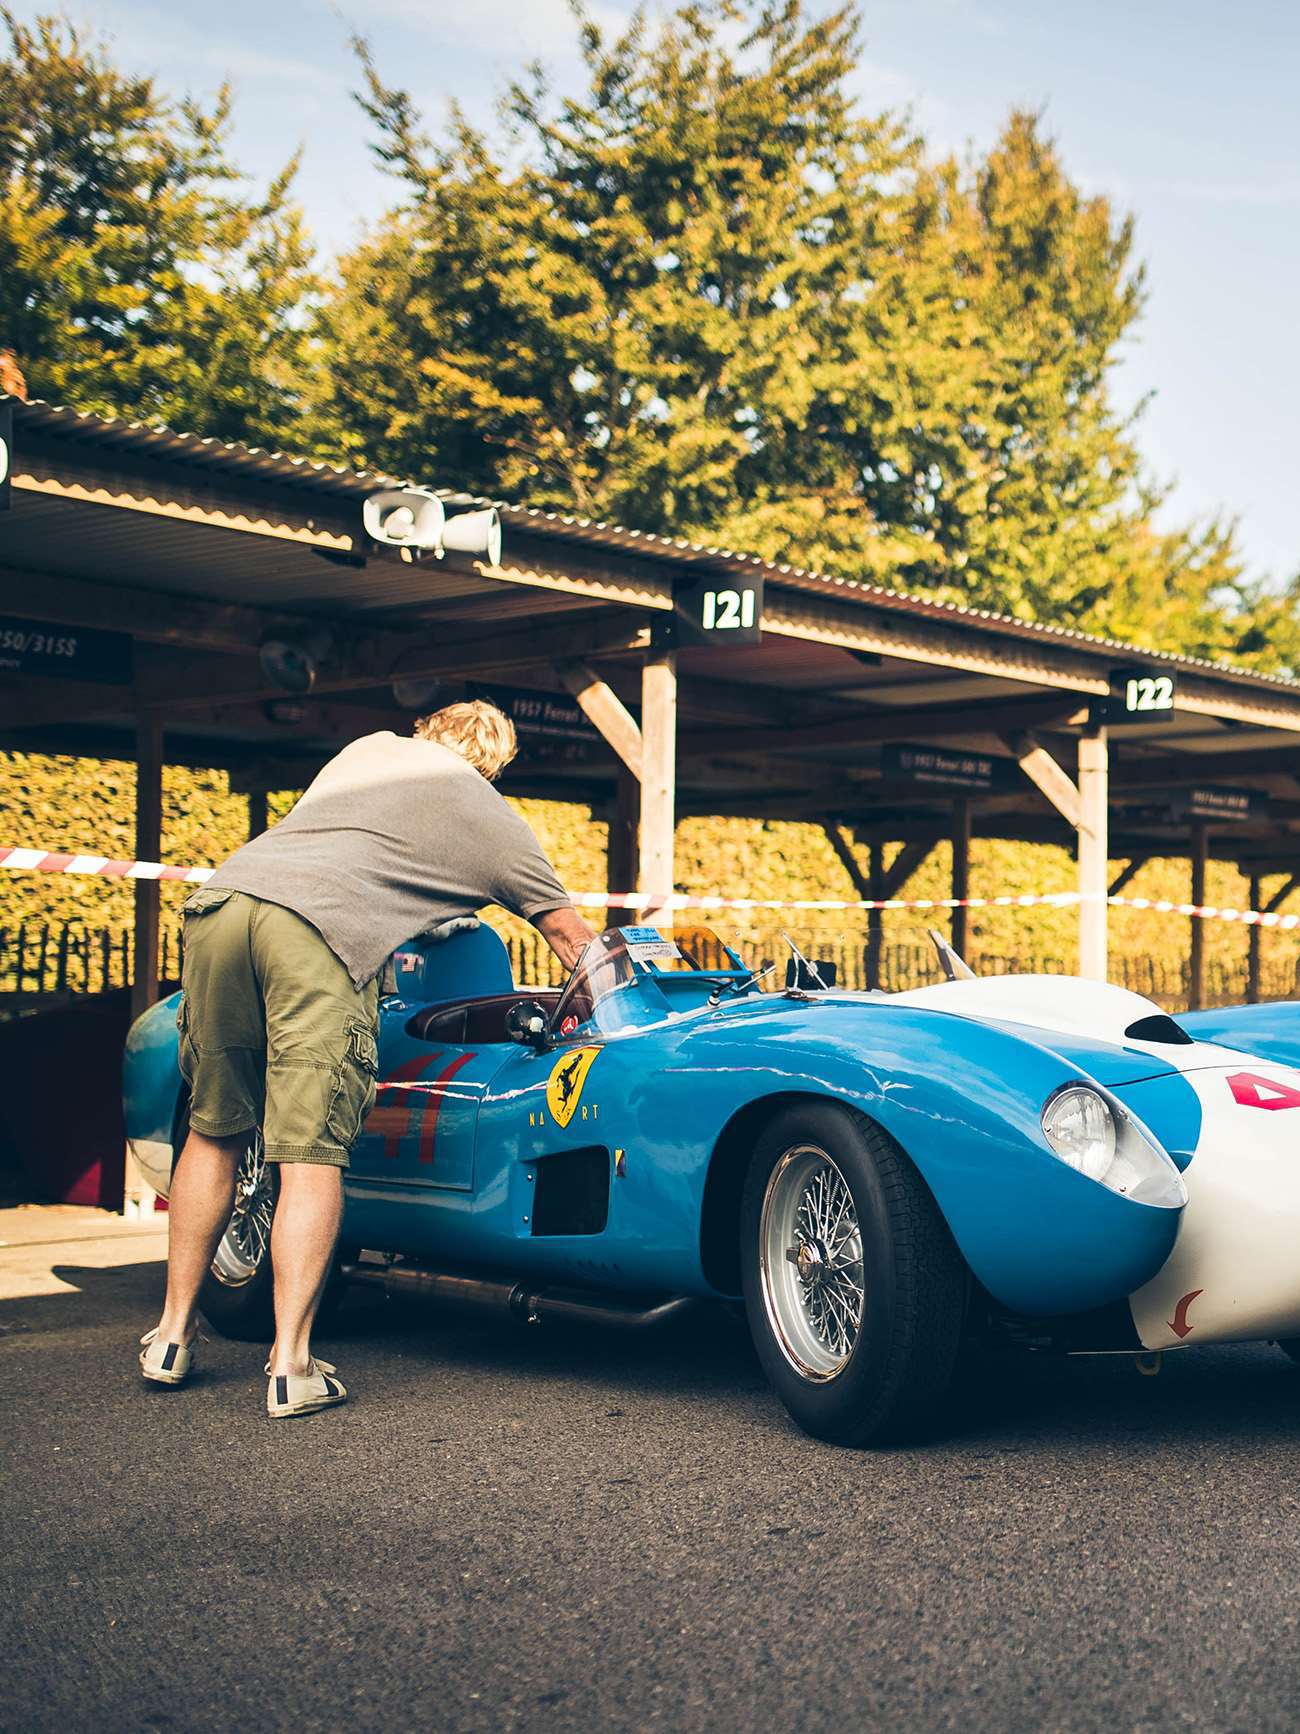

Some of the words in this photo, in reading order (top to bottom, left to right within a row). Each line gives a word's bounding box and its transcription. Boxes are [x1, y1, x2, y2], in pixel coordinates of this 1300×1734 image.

[702, 589, 755, 630] 121
[0, 629, 78, 658] 50/315S
[1126, 676, 1173, 711] 122
